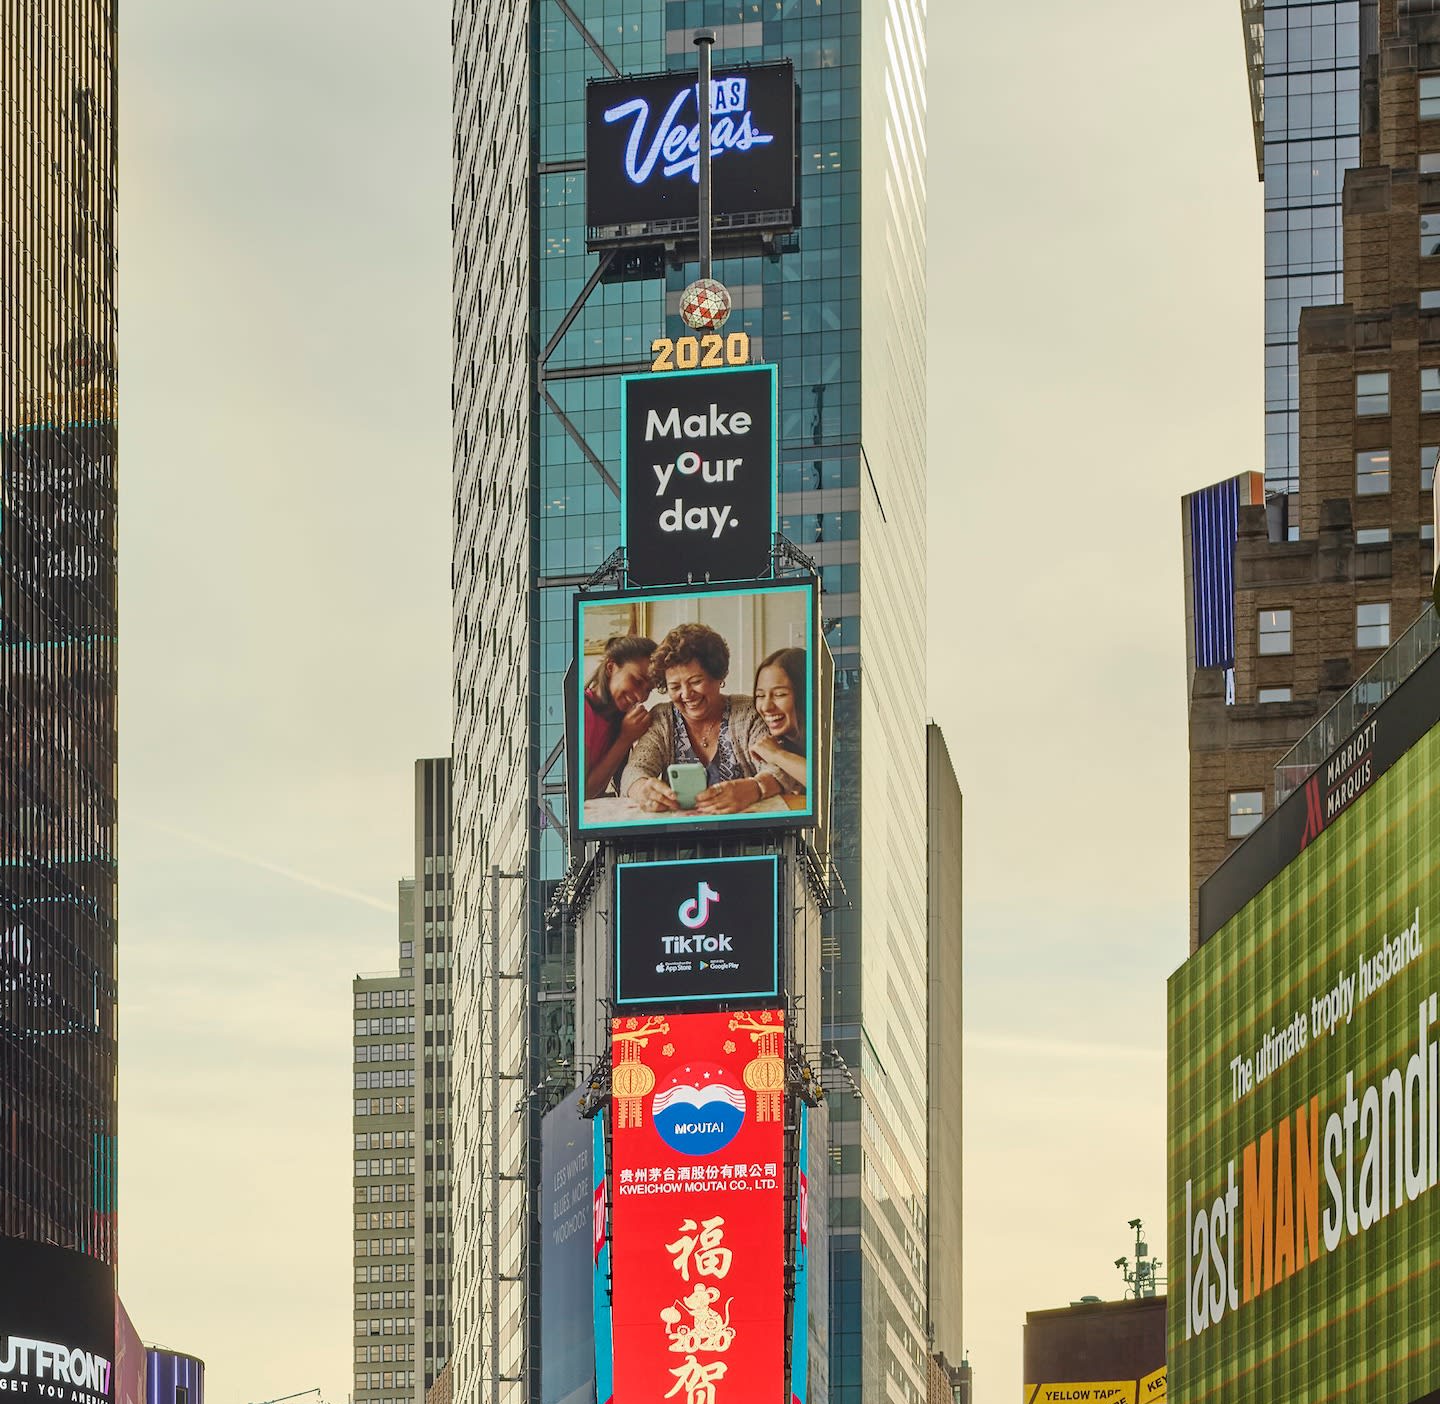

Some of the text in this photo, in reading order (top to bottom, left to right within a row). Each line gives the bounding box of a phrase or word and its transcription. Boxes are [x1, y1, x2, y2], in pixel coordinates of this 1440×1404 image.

[651, 332, 749, 371] 2020
[645, 404, 752, 441] Make
[653, 451, 743, 496] your
[659, 498, 739, 538] day.
[1326, 719, 1378, 786] MARRIOTT
[1327, 759, 1371, 818] MARQUIS
[661, 934, 734, 955] TikTok
[1230, 906, 1424, 1103] The ultimate trophy husband.
[674, 1122, 724, 1135] MOUTAI
[619, 1162, 777, 1184] 贵州茅台酒股份有限公司
[619, 1176, 778, 1196] KWEICHOW MOUTAI CO., LTD.
[1185, 1160, 1240, 1341] last
[1242, 1096, 1320, 1304] MAN
[665, 1216, 733, 1281] 福
[0, 1378, 29, 1393] GET
[37, 1381, 65, 1400] YOU
[1046, 1390, 1091, 1401] YELLOW
